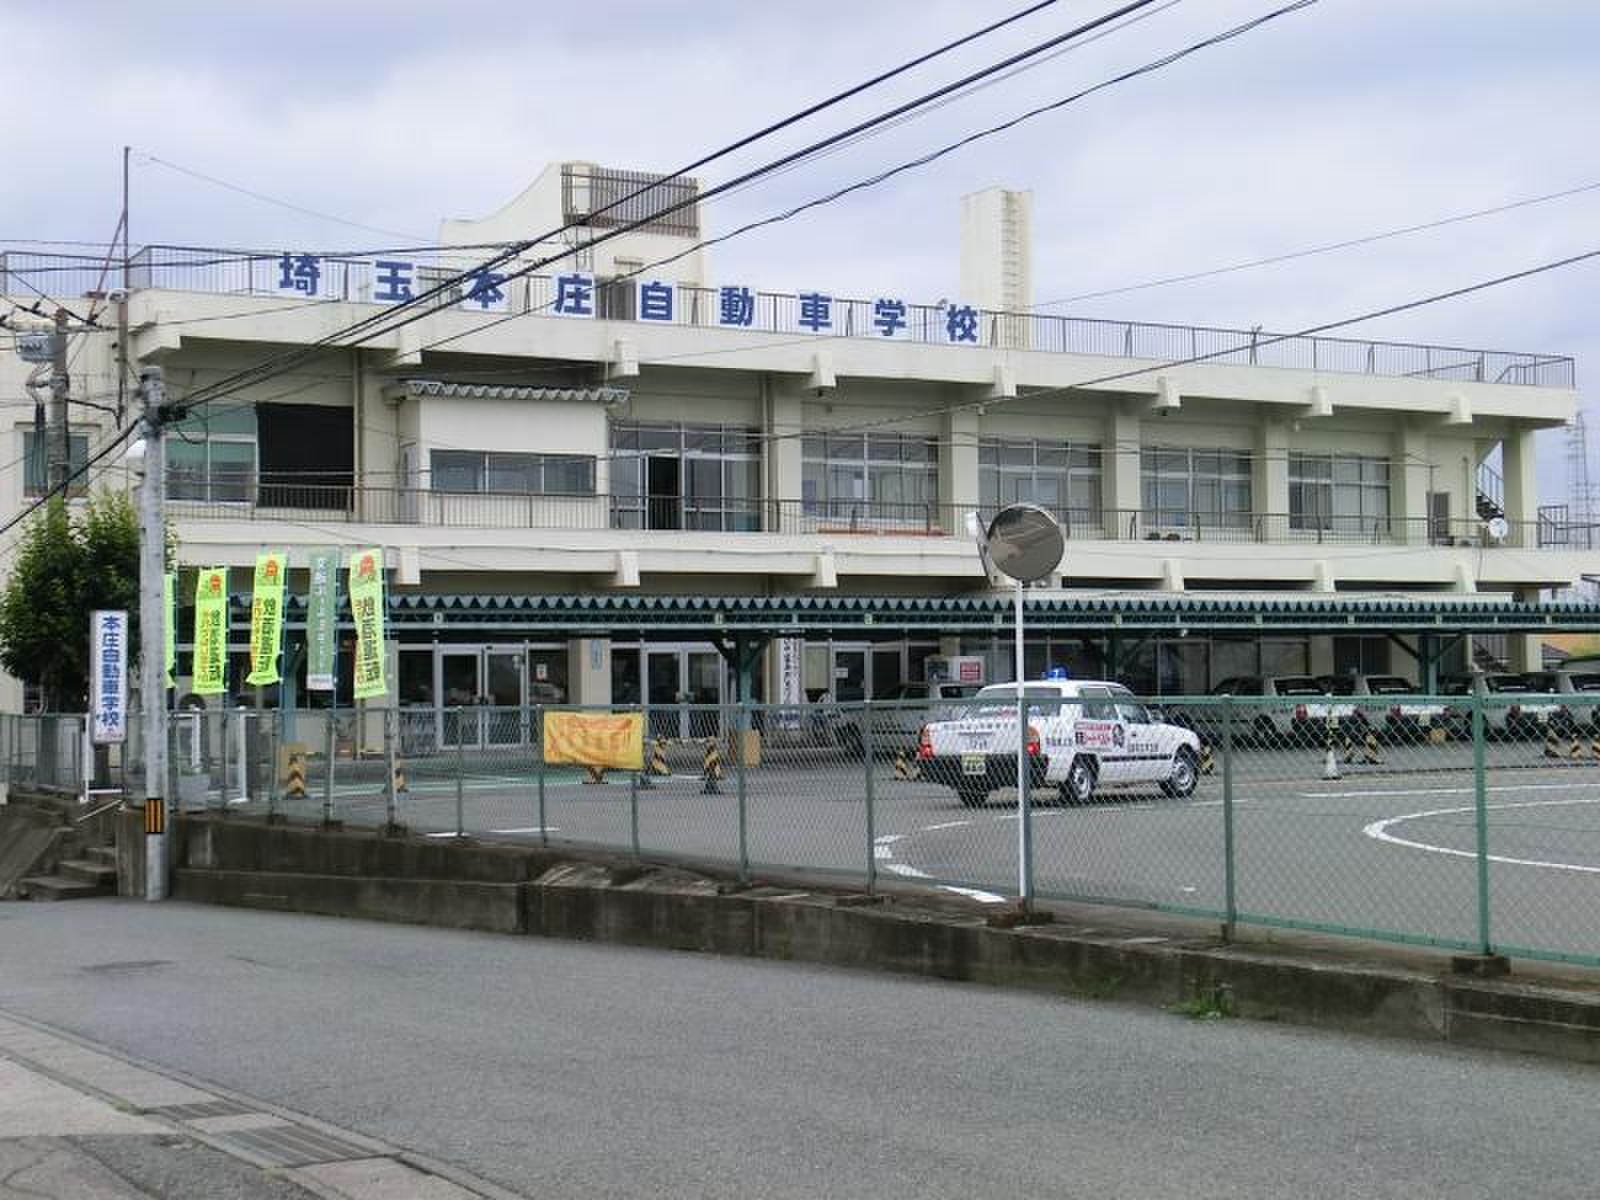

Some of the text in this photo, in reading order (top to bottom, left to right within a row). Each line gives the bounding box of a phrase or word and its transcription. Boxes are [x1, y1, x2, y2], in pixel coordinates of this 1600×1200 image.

[278, 252, 979, 344] 埼玉本庄自動車学校
[101, 614, 121, 727] 本庄自動車学校
